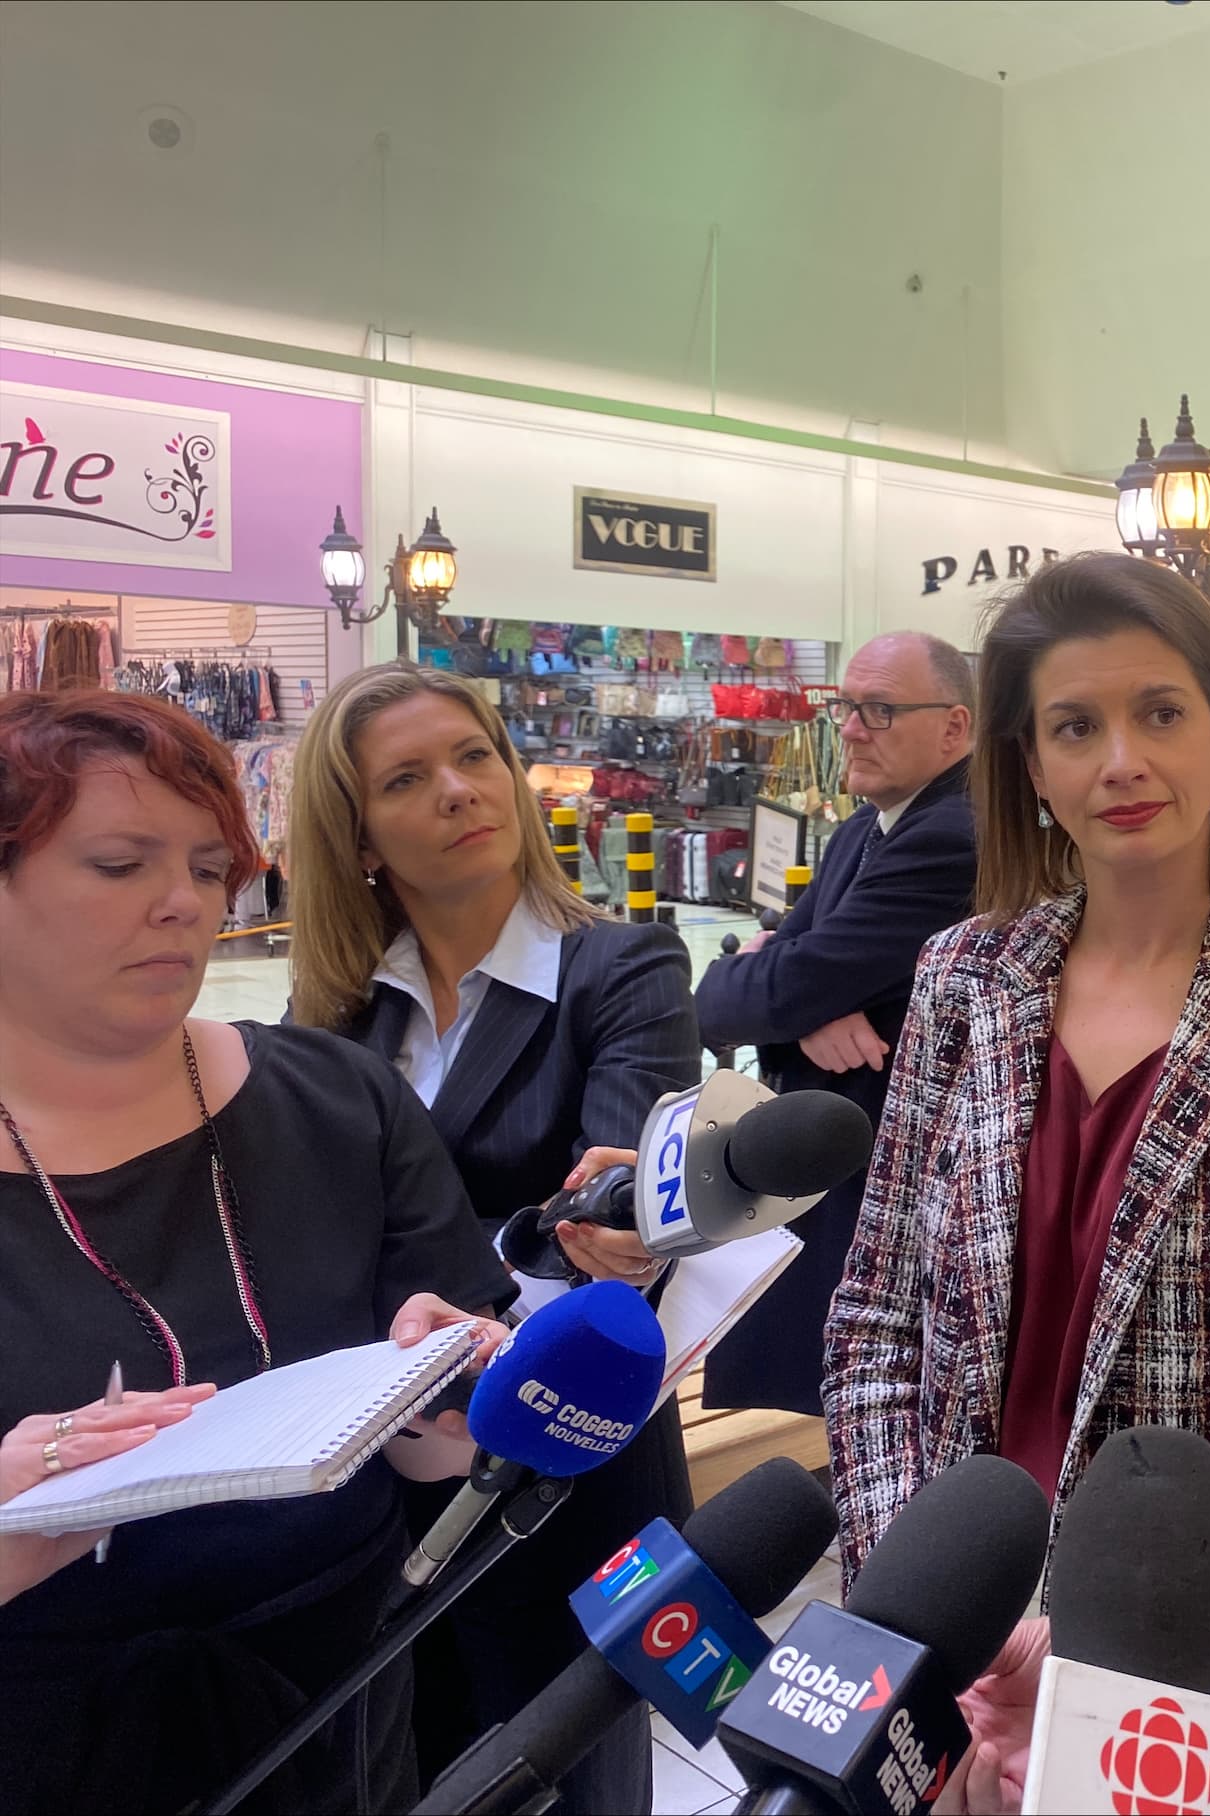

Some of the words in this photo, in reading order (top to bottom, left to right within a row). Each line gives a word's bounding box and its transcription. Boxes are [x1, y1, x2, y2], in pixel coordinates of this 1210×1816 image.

[587, 514, 705, 554] VOGUE
[657, 1099, 698, 1226] LCN
[544, 1422, 620, 1454] NOUVELLES
[600, 1545, 653, 1598] CTV
[651, 1610, 744, 1706] CTV
[768, 1645, 873, 1710] Global
[767, 1682, 848, 1735] NEWS
[876, 1752, 917, 1816] NEWS
[888, 1708, 937, 1799] Global
